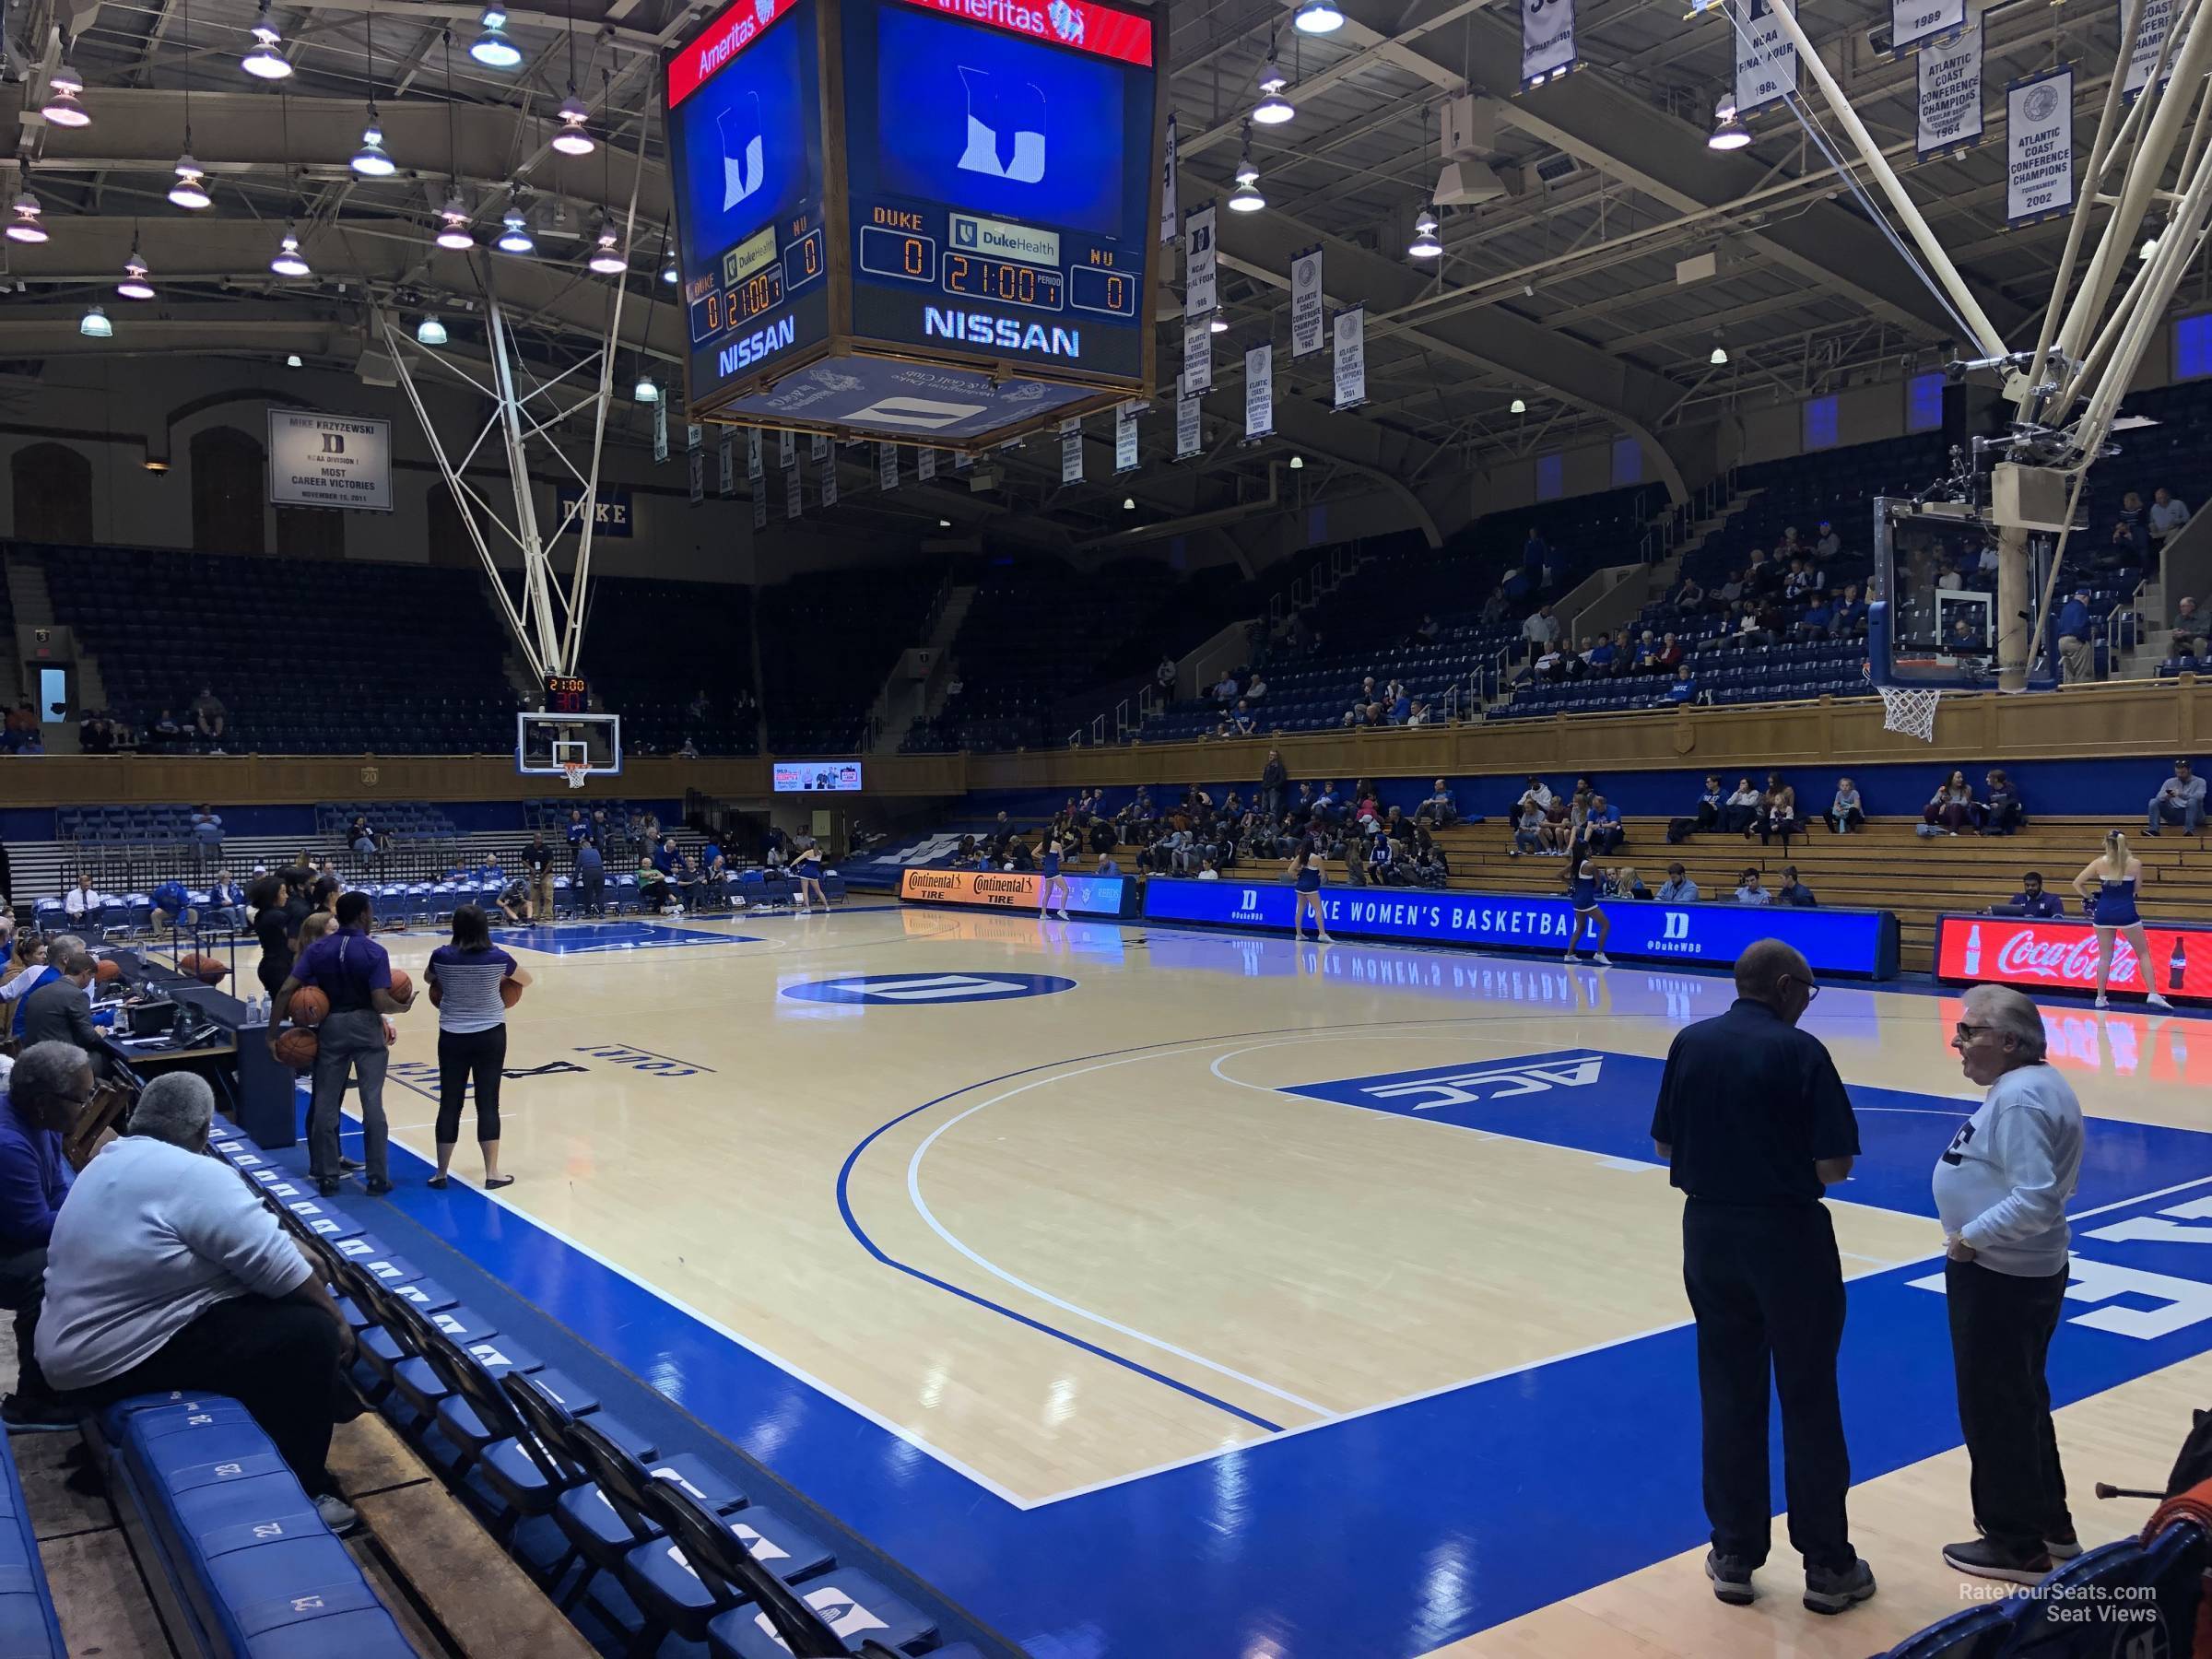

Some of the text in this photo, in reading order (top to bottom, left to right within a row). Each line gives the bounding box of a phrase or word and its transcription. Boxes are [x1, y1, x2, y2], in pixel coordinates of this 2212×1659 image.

[938, 0, 1044, 33] meritas
[1914, 10, 1941, 29] 1989
[699, 14, 756, 79] Ameritas
[1753, 29, 1778, 49] NCAA
[1928, 53, 1971, 77] ATLANTIC
[1936, 67, 1964, 88] COAST
[1921, 75, 1979, 105] CONFERENCE
[1923, 88, 1975, 117] CHAMPIONS
[1936, 123, 1960, 138] 1964
[2018, 127, 2061, 147] ATLANTIC
[2025, 141, 2054, 158] COAST
[2011, 148, 2070, 174] CONFERENCE
[2013, 162, 2067, 186] CHAMPIONS
[2027, 193, 2053, 208] 2002
[793, 215, 807, 238] NU
[874, 206, 924, 231] DUKE
[738, 238, 775, 269] DukeHealth
[983, 231, 1055, 257] DukeHealth
[804, 238, 816, 275] 0
[903, 238, 923, 276] 0
[1090, 248, 1113, 267] NU
[693, 272, 714, 296] DUKE
[951, 255, 1035, 304] 21:00
[1037, 274, 1062, 288] PERIOD
[1187, 278, 1198, 289] FIAL
[728, 274, 770, 325] 21:00
[1107, 276, 1123, 309] 0
[1296, 289, 1318, 305] ATLANTIC
[708, 296, 718, 329] 0
[1292, 307, 1322, 324] CONFERENCE
[1300, 300, 1315, 312] COAST
[924, 306, 1080, 359] NISSAN
[1293, 316, 1321, 333] CHAMPIONS
[719, 314, 795, 379] NISSAN
[289, 418, 374, 434] MIKE KRZYZEWSKI
[326, 456, 354, 465] DIVISION
[321, 467, 347, 477] MOST
[291, 476, 376, 490] CAREER VICTORIES
[301, 491, 337, 500] NOVEMBER
[549, 678, 584, 691] 21:00
[363, 771, 377, 782] 20
[909, 871, 955, 891] Continental
[973, 874, 1025, 895] Continental
[922, 889, 945, 900] TIRE
[987, 894, 1015, 904] TIRE
[1231, 912, 1264, 921] @DukeWBB
[1296, 899, 1597, 938] UKE WOMEN'S BASKETBAL
[1647, 940, 1701, 954] @DukeWBB
[571, 1044, 698, 1077] COURT
